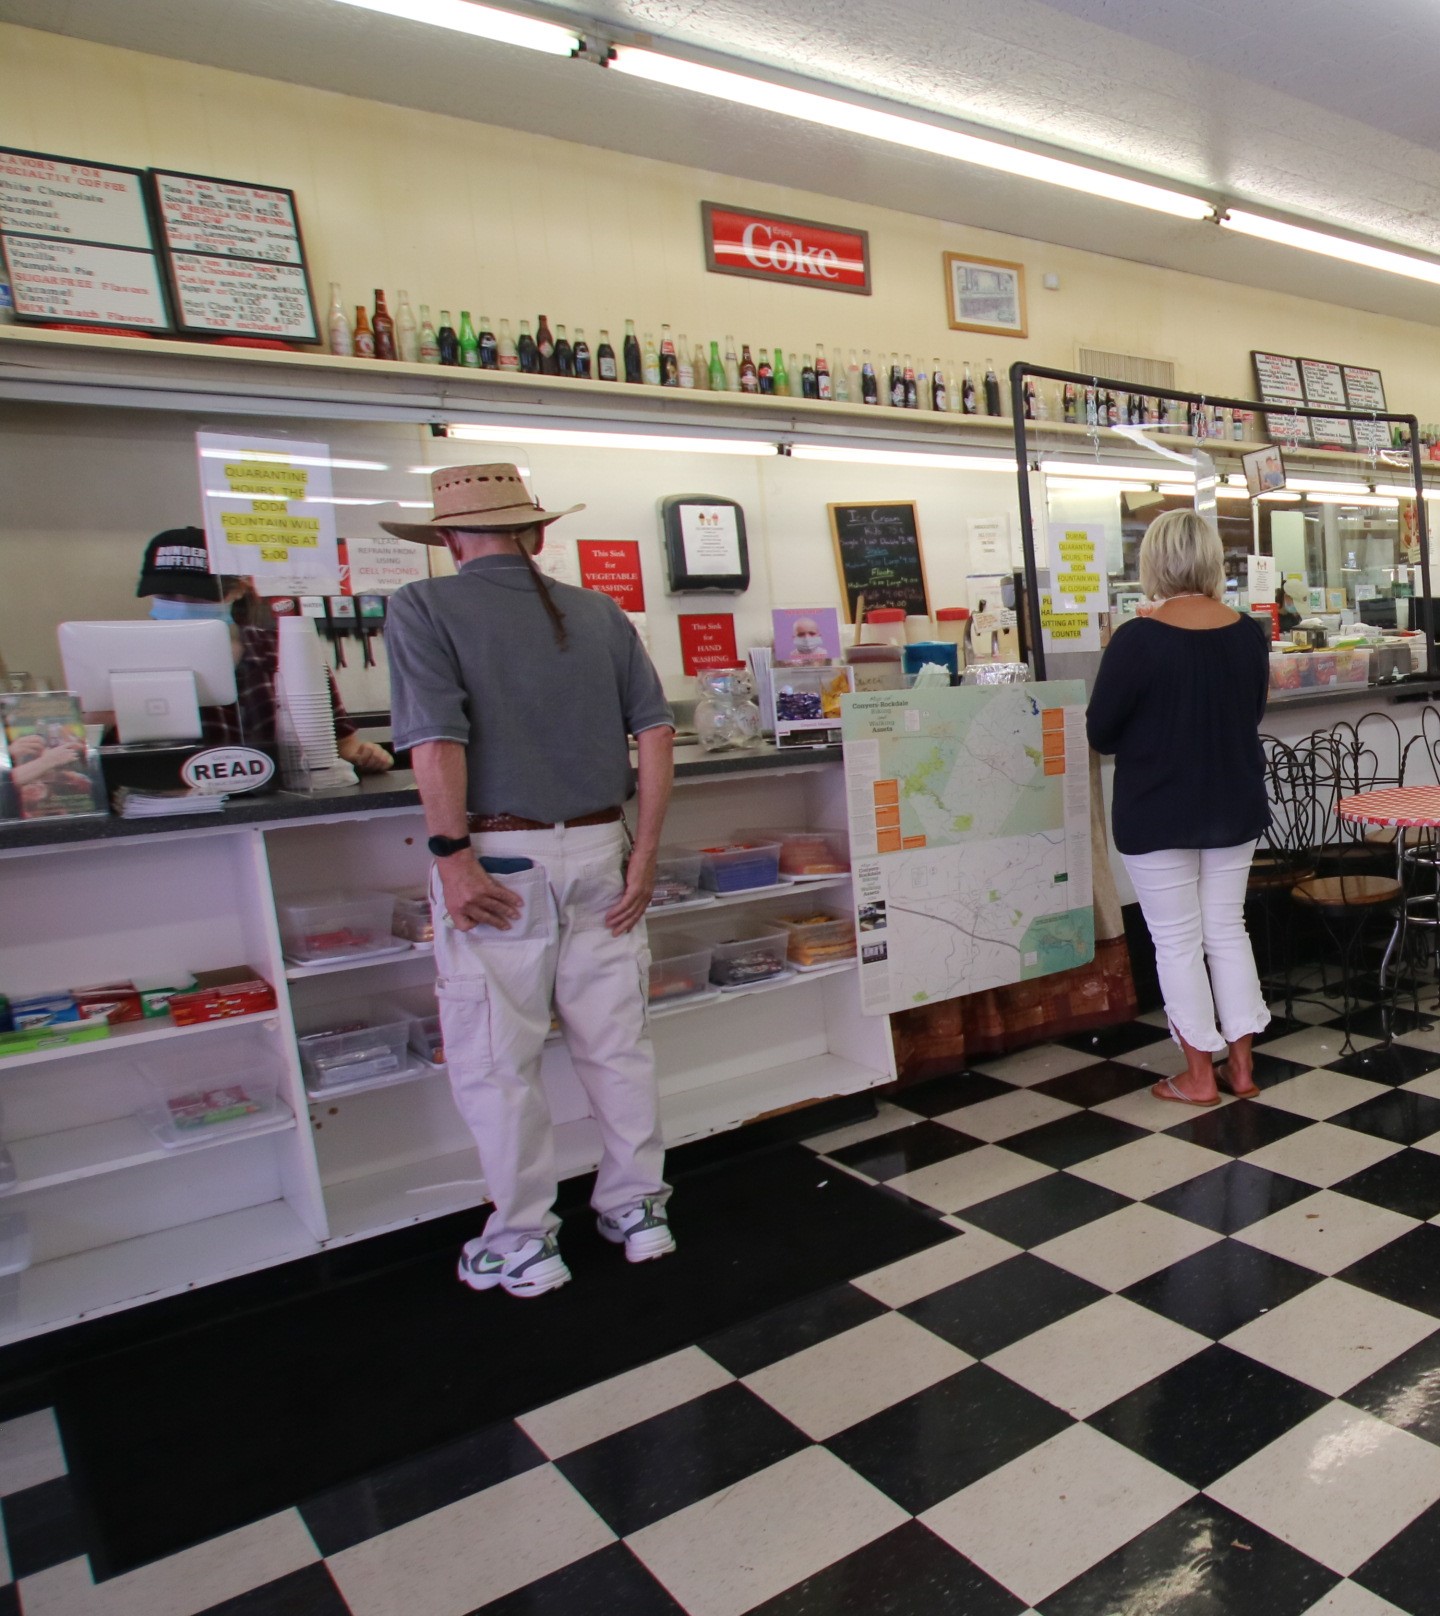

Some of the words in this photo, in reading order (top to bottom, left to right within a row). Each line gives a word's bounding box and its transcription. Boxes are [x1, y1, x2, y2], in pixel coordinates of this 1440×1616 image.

[0, 154, 55, 171] LAVORS
[71, 166, 102, 178] FOR
[77, 178, 126, 192] COFFEE
[0, 180, 31, 193] hite
[38, 186, 104, 203] Chocolate
[1, 216, 71, 233] Chocolate
[7, 237, 74, 254] Raspberry
[742, 222, 840, 279] Coke
[10, 249, 55, 262] Vanilla
[13, 259, 69, 275] Pumpkin
[74, 267, 94, 277] Pie
[15, 283, 72, 298] Caramel
[101, 282, 149, 296] Flavors
[18, 292, 68, 305] Vanilla
[48, 305, 58, 315] &
[63, 308, 99, 319] match
[107, 311, 155, 324] Flavors
[225, 466, 307, 483] QUARANTINE
[283, 487, 305, 499] THE
[253, 502, 287, 512] SODA
[222, 516, 288, 529] FOUNTAIN
[291, 518, 319, 531] WILL
[227, 532, 242, 543] BE
[246, 533, 299, 546] CLOSING
[302, 536, 318, 546] AT
[358, 547, 391, 555] REFRAIN
[1058, 543, 1095, 551] QUARANTINE
[261, 549, 289, 560] 5:00
[592, 549, 610, 558] This
[610, 550, 626, 558] Sink
[376, 557, 401, 565] USING
[604, 561, 616, 570] for
[359, 567, 381, 576] CELL
[383, 567, 420, 576] PHONES
[1070, 564, 1086, 572] SODA
[585, 572, 638, 582] VEGETABLE
[1058, 574, 1087, 582] FOUNTAIN
[1087, 574, 1100, 582] WILL
[591, 584, 634, 593] WASHING
[1060, 585, 1067, 593] BE
[1092, 584, 1099, 592] AT
[691, 622, 708, 631] This
[708, 622, 723, 630] Sink
[1041, 619, 1066, 627] SITTING
[1077, 618, 1088, 626] THE
[702, 632, 714, 641] for
[1051, 630, 1081, 638] COUNTER
[697, 644, 723, 653] HAND
[691, 655, 730, 664] WASHING
[852, 700, 909, 711] Conyers-Rockdale
[868, 720, 895, 729] Walking
[872, 726, 893, 734] Assets
[194, 760, 266, 781] READ
